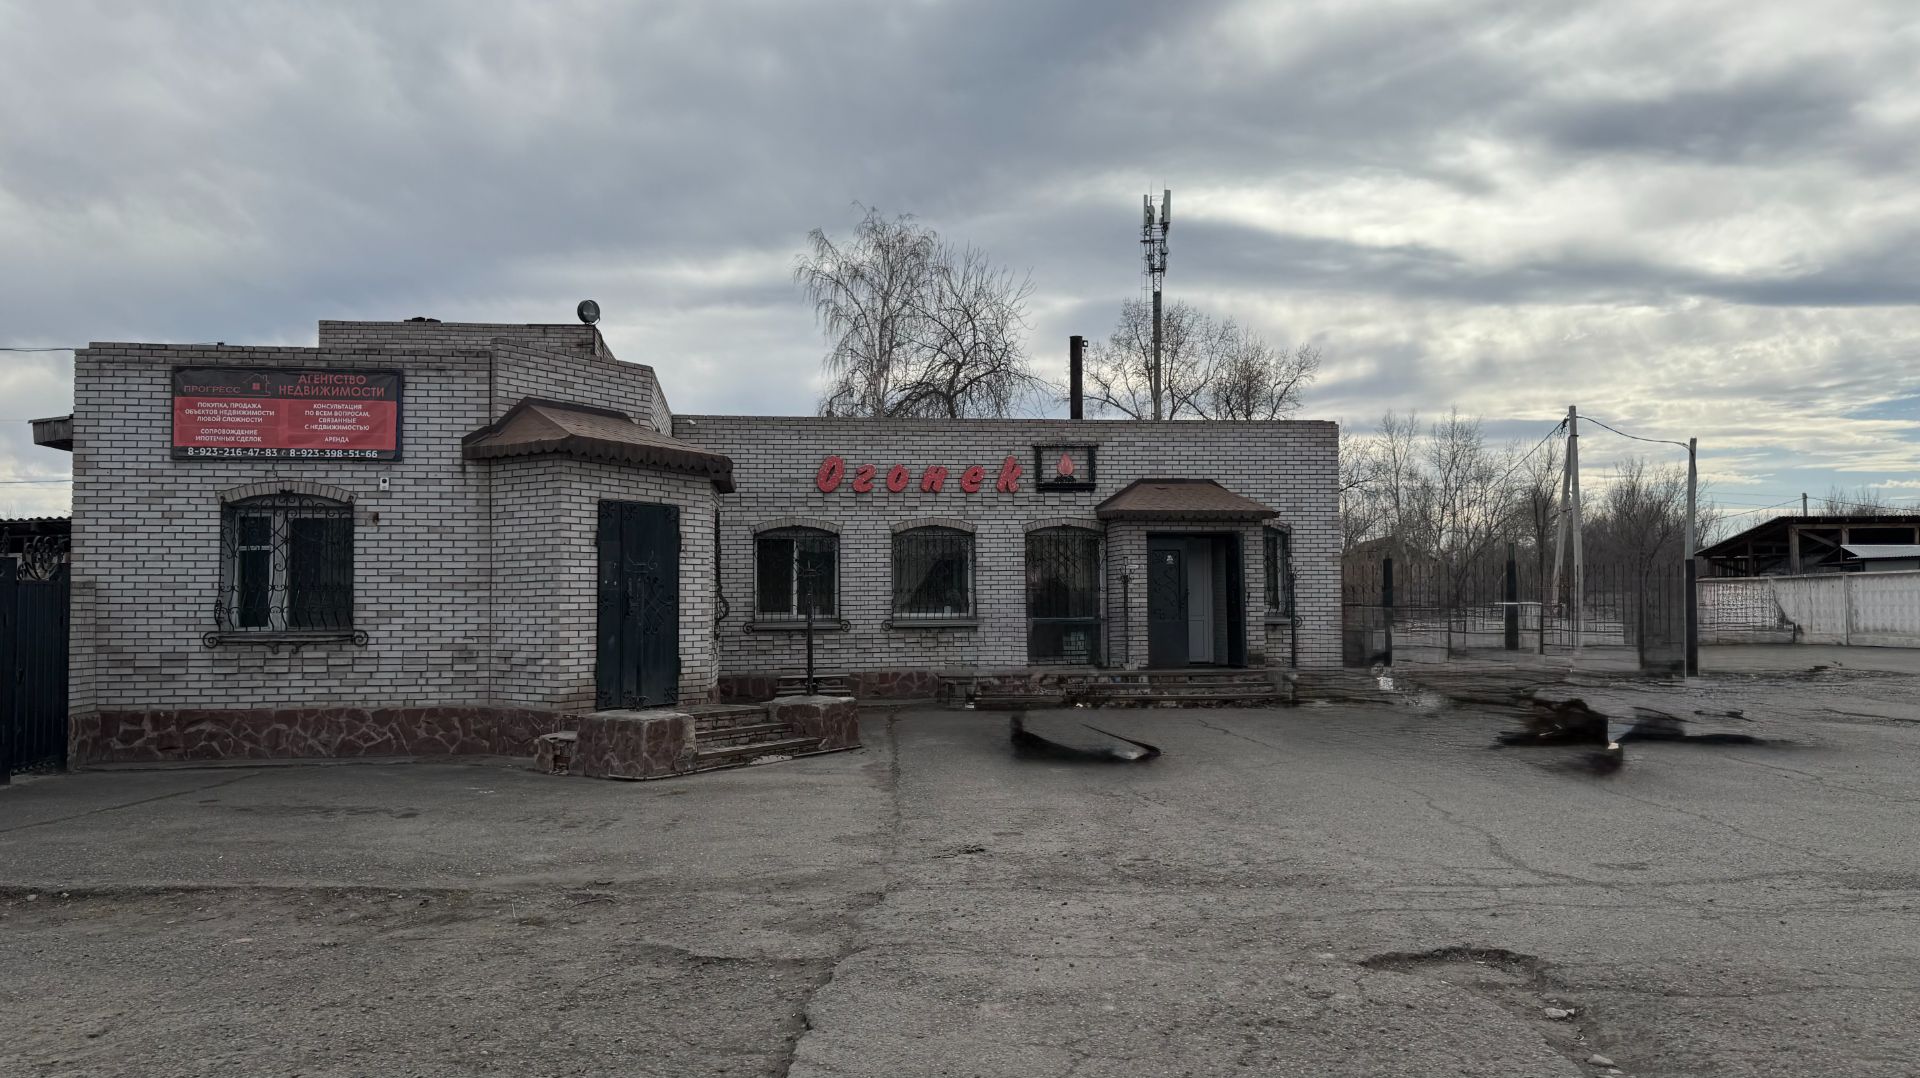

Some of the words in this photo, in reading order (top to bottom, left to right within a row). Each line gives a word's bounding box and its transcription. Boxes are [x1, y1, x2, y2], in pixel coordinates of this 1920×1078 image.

[298, 374, 366, 385] АГЕНТСТВО
[184, 385, 240, 393] ПРОГРЕСС
[279, 386, 385, 397] НЕДВИЖИМОСТИ
[187, 447, 277, 456] 8-923-216-47-83
[290, 450, 378, 458] 8-923-398-51-66
[816, 455, 1022, 493] Огонек
